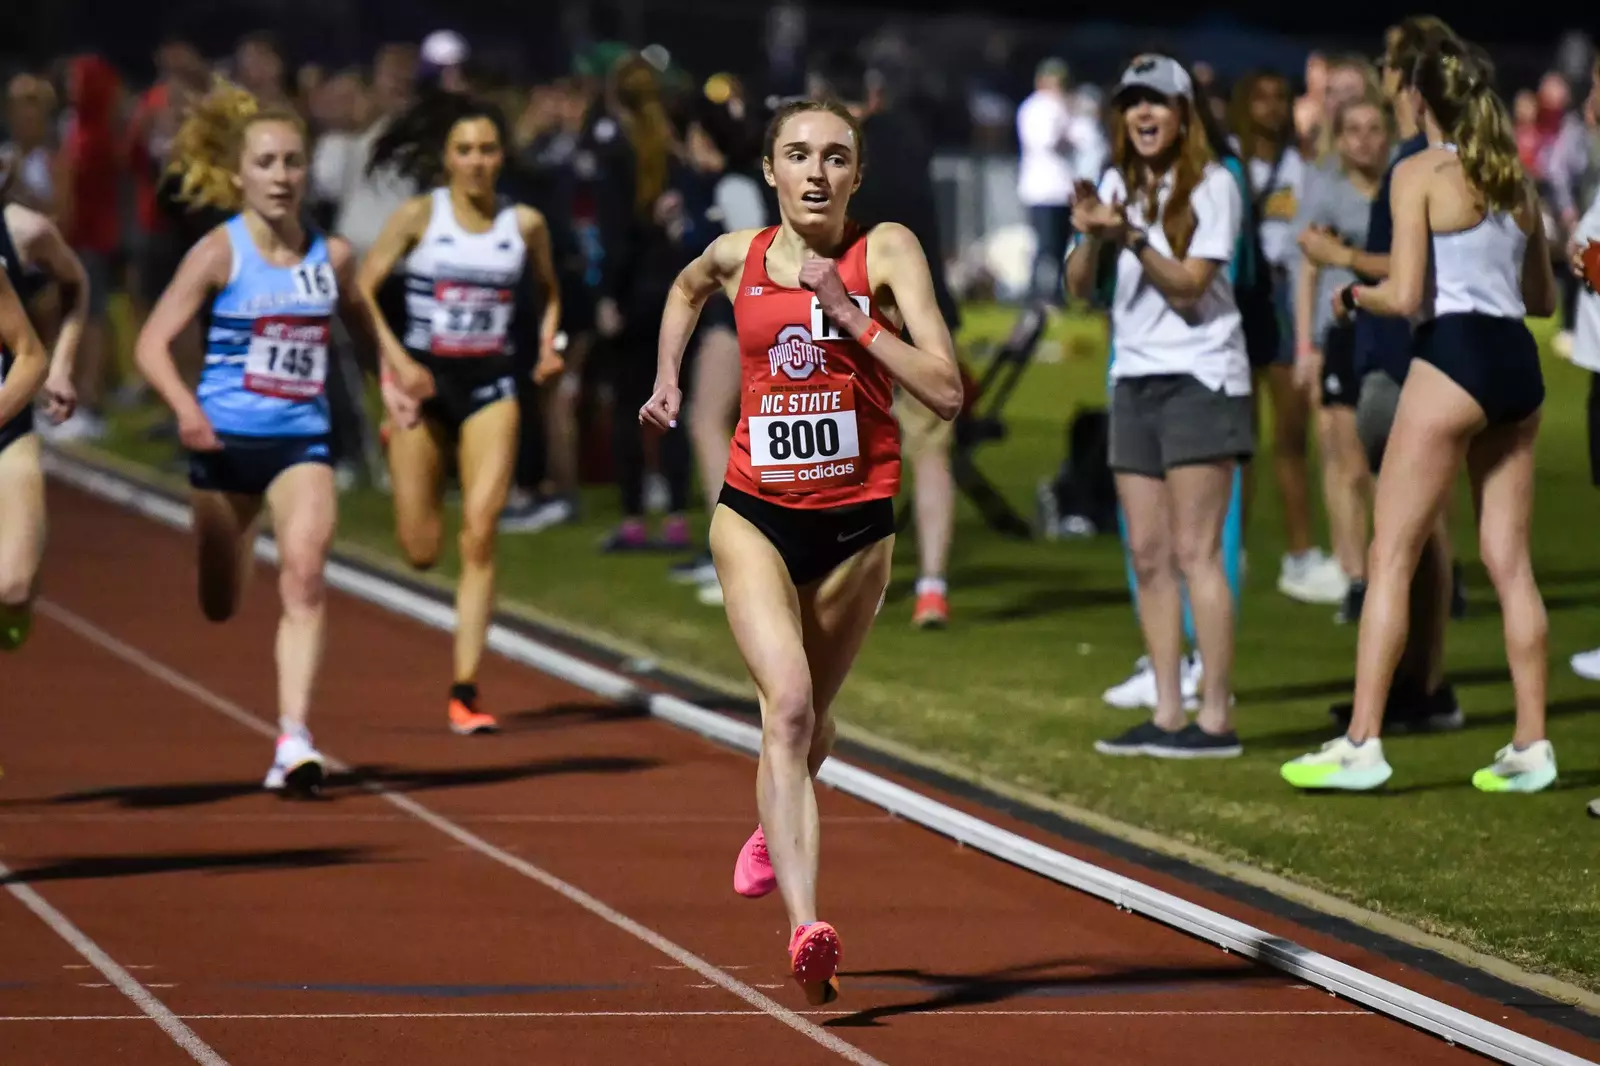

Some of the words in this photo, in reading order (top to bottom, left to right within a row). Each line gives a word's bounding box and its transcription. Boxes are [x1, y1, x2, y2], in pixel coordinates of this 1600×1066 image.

[298, 264, 331, 295] 16
[266, 345, 315, 377] 145
[760, 394, 784, 414] NC
[788, 391, 842, 413] STATE
[767, 417, 840, 461] 800
[797, 463, 855, 481] adidas
